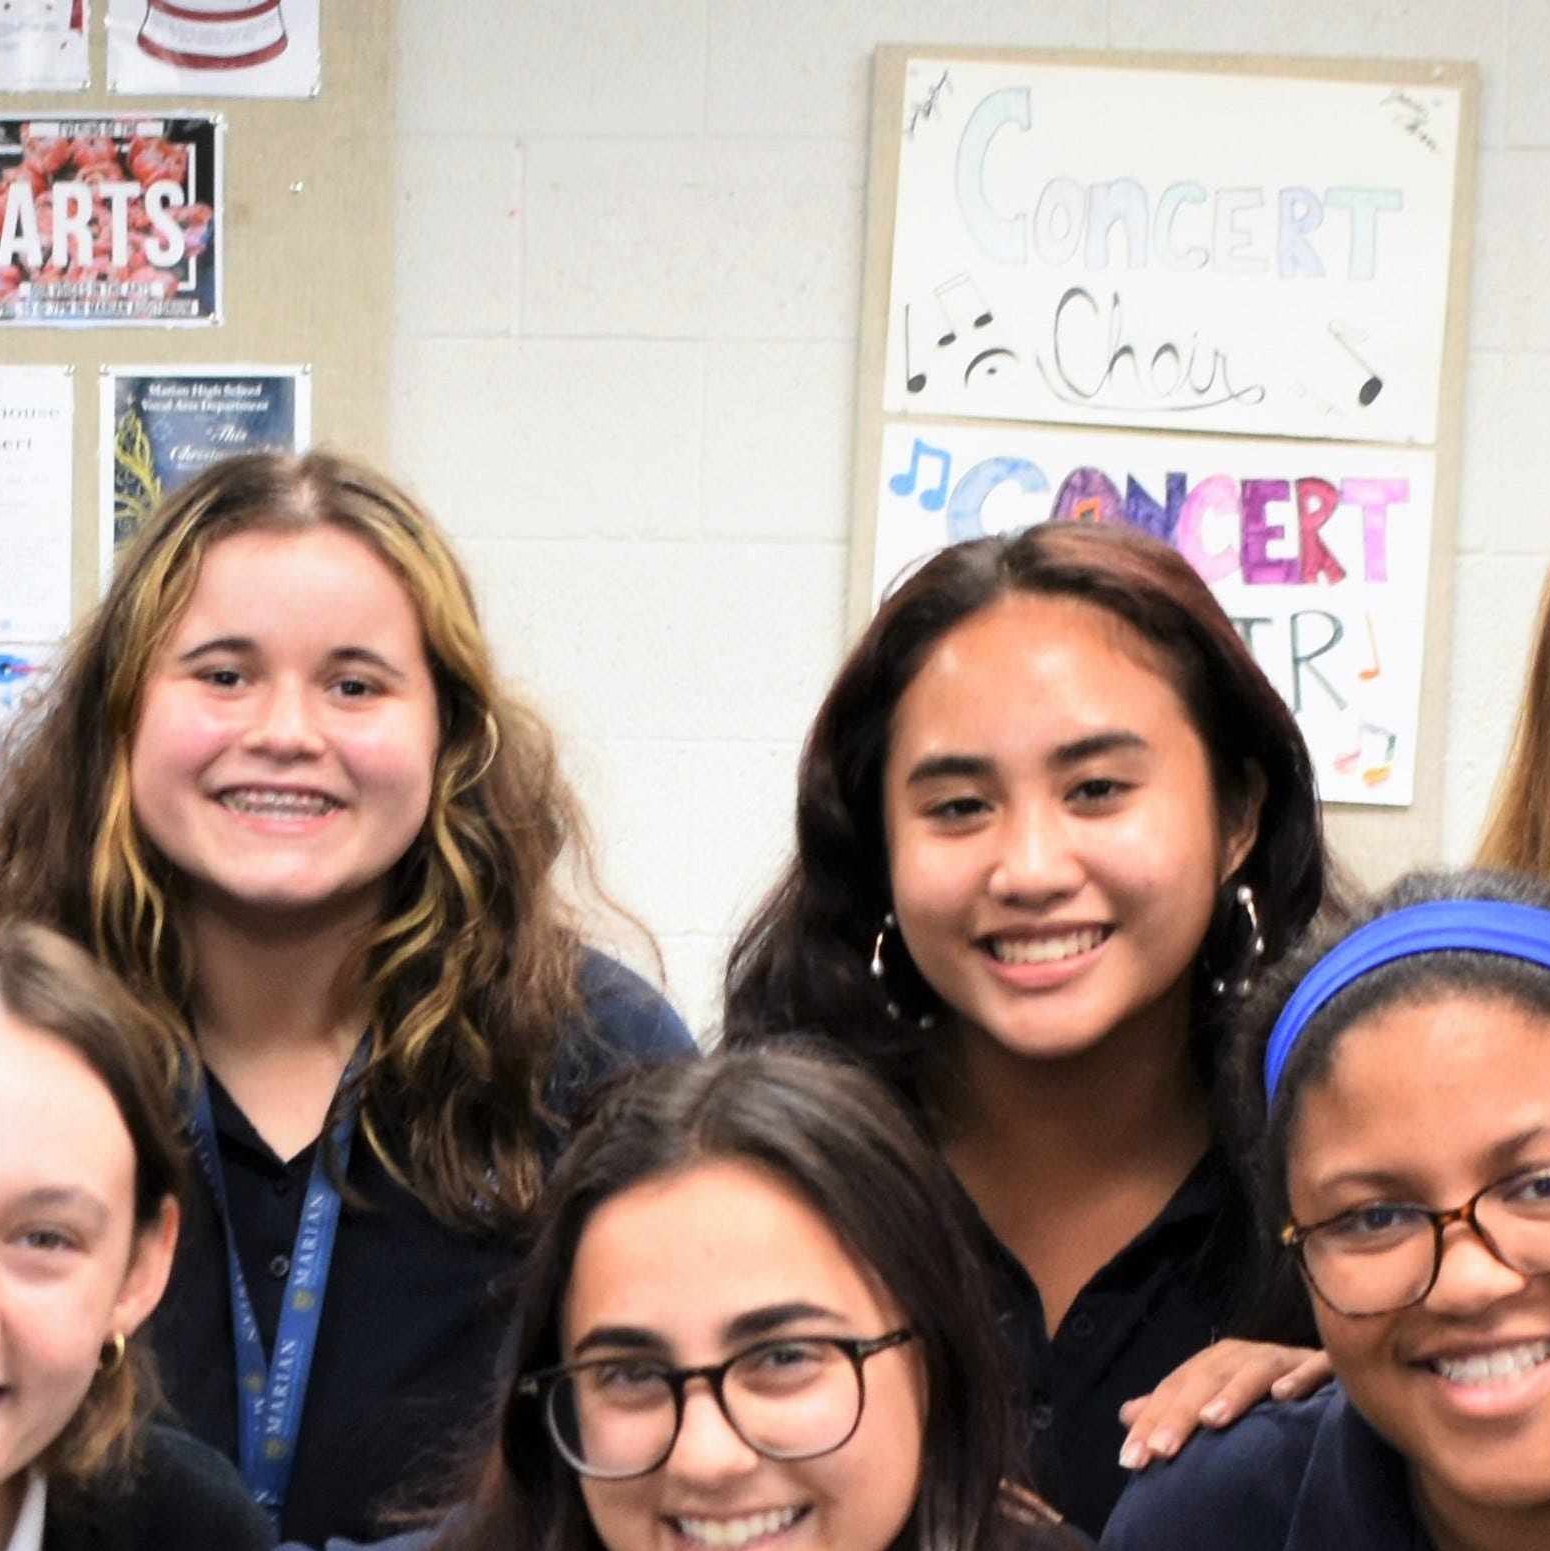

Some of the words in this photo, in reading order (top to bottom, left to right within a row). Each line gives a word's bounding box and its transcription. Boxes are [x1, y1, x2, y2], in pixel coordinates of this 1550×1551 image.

[1037, 286, 1266, 413] Choir
[294, 1194, 326, 1287] MARIAN
[265, 1339, 298, 1434] MARIAN
